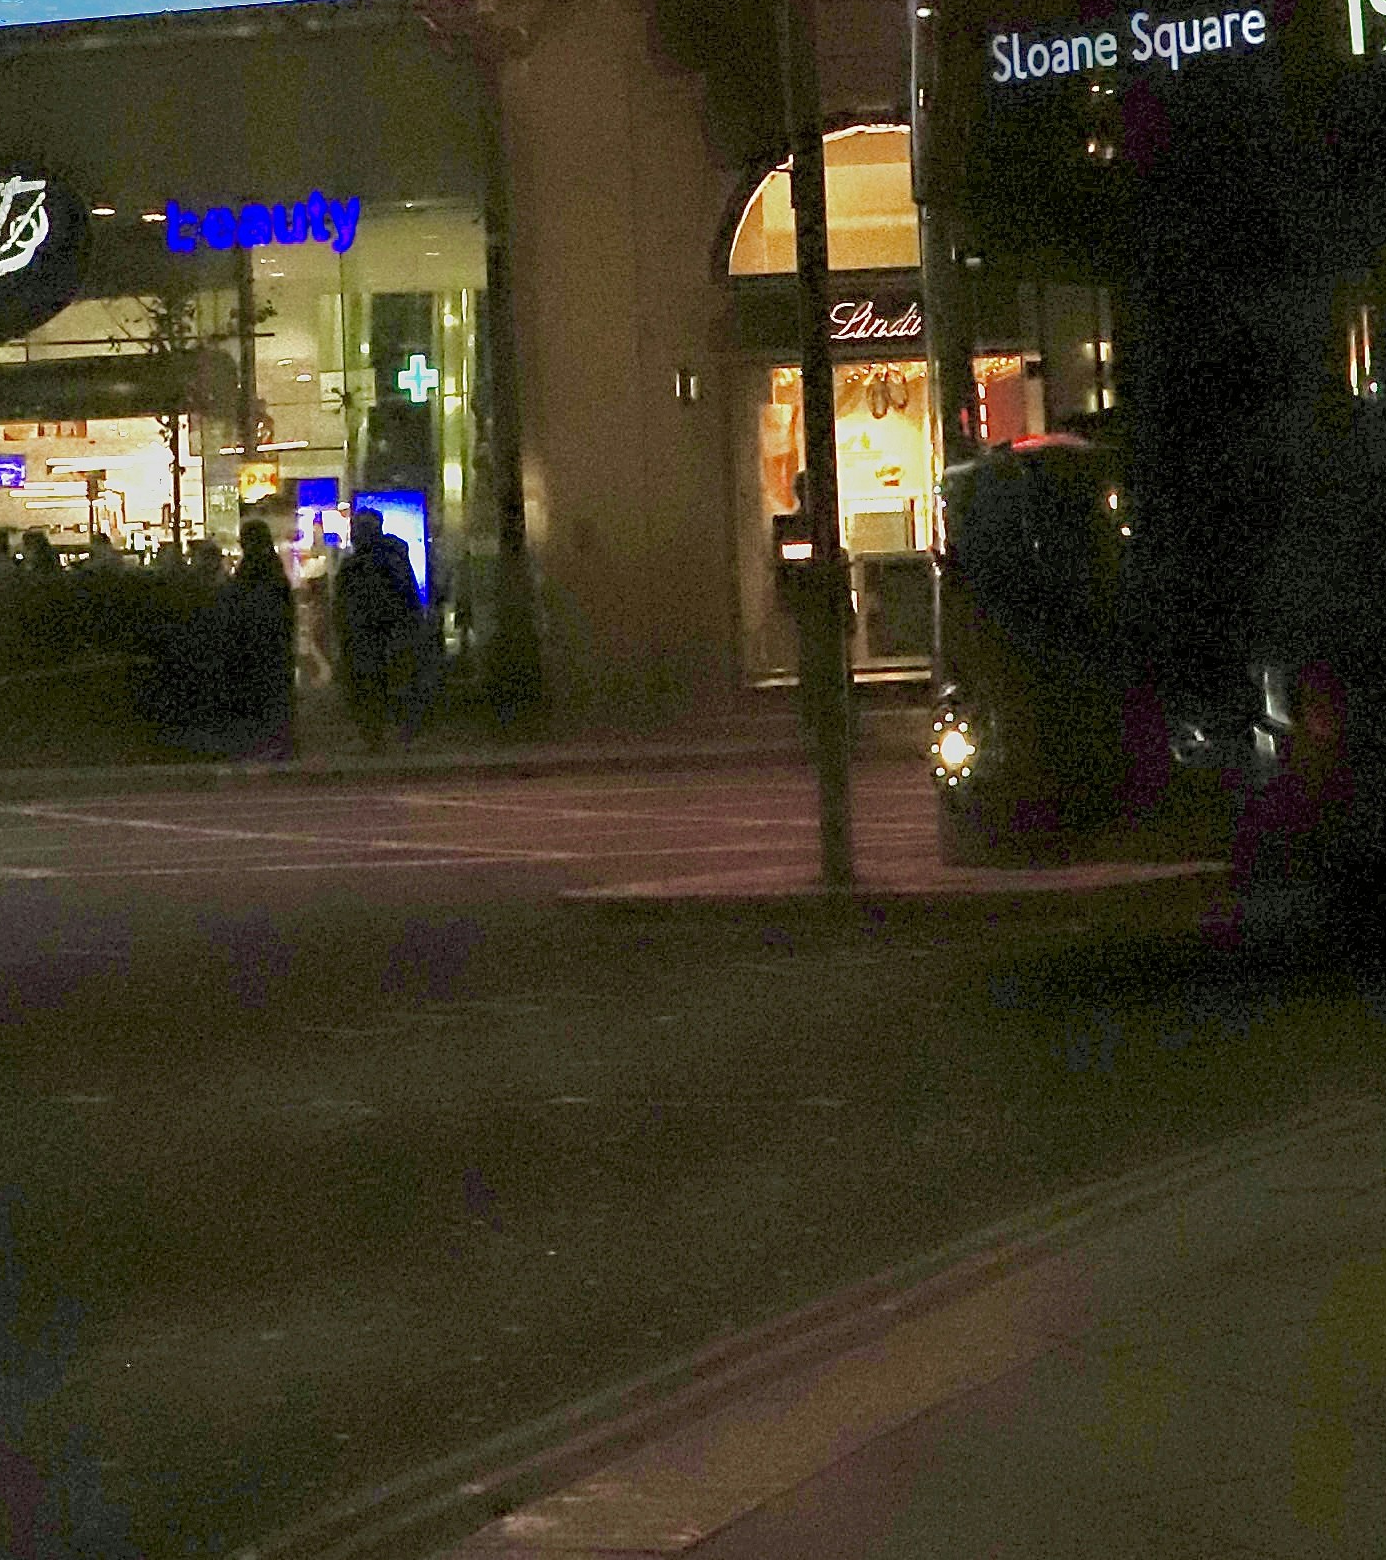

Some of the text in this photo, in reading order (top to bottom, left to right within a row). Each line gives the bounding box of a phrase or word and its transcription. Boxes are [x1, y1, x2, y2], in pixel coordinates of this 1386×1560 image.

[991, 8, 1266, 83] Sloane Square
[166, 188, 361, 254] beauty
[829, 300, 922, 340] Lindt
